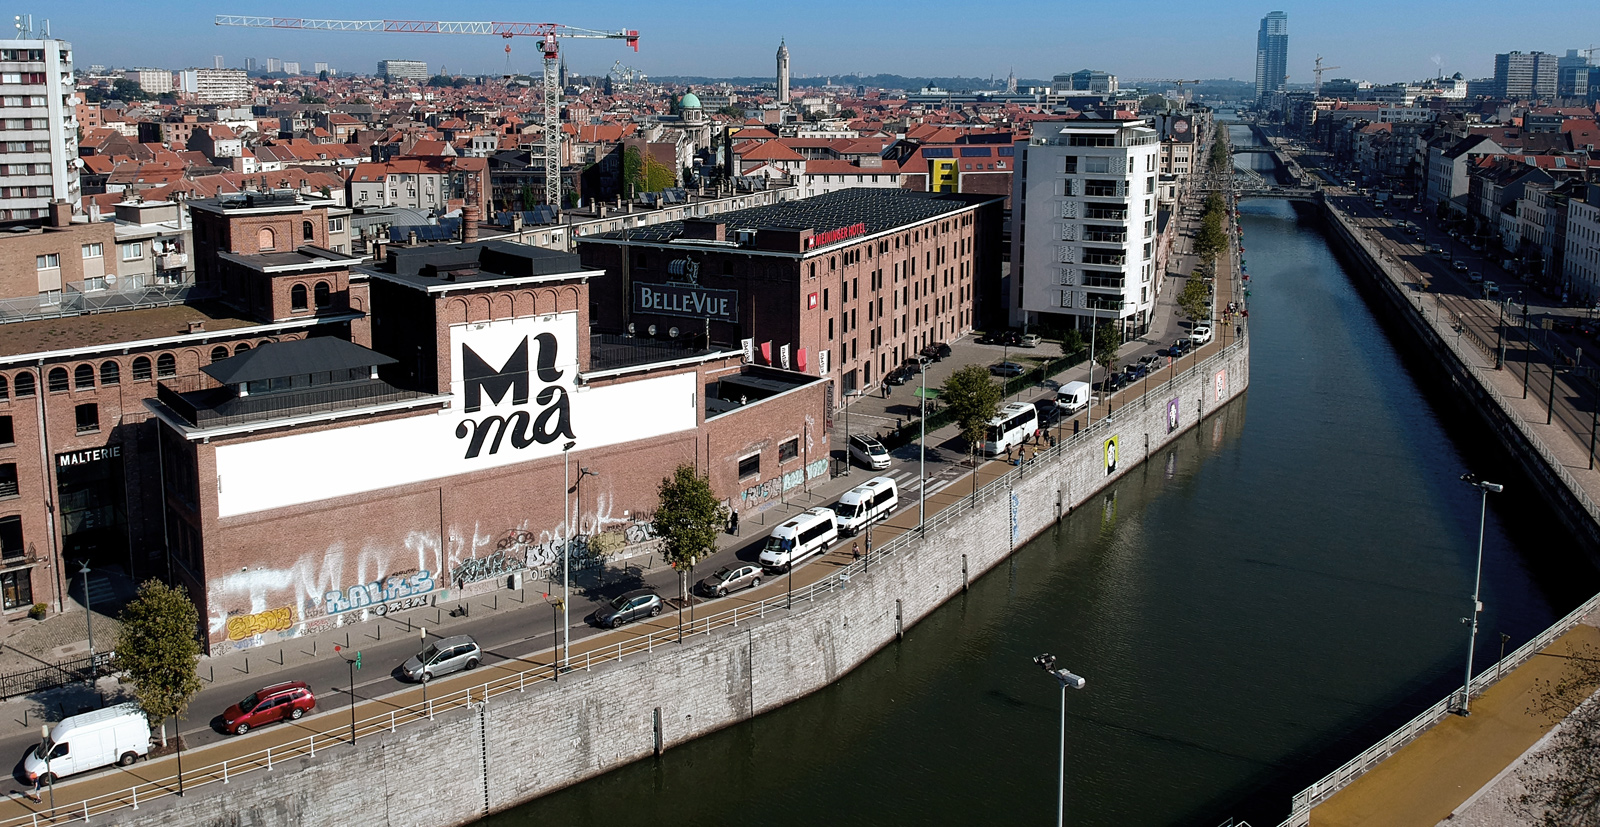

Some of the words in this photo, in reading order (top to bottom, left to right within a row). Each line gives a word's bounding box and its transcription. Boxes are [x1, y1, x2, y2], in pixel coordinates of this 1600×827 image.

[816, 227, 848, 246] MEININGER
[849, 223, 866, 236] HOTEL
[641, 287, 730, 316] BELLE-VUE
[60, 446, 121, 467] MALTERIE
